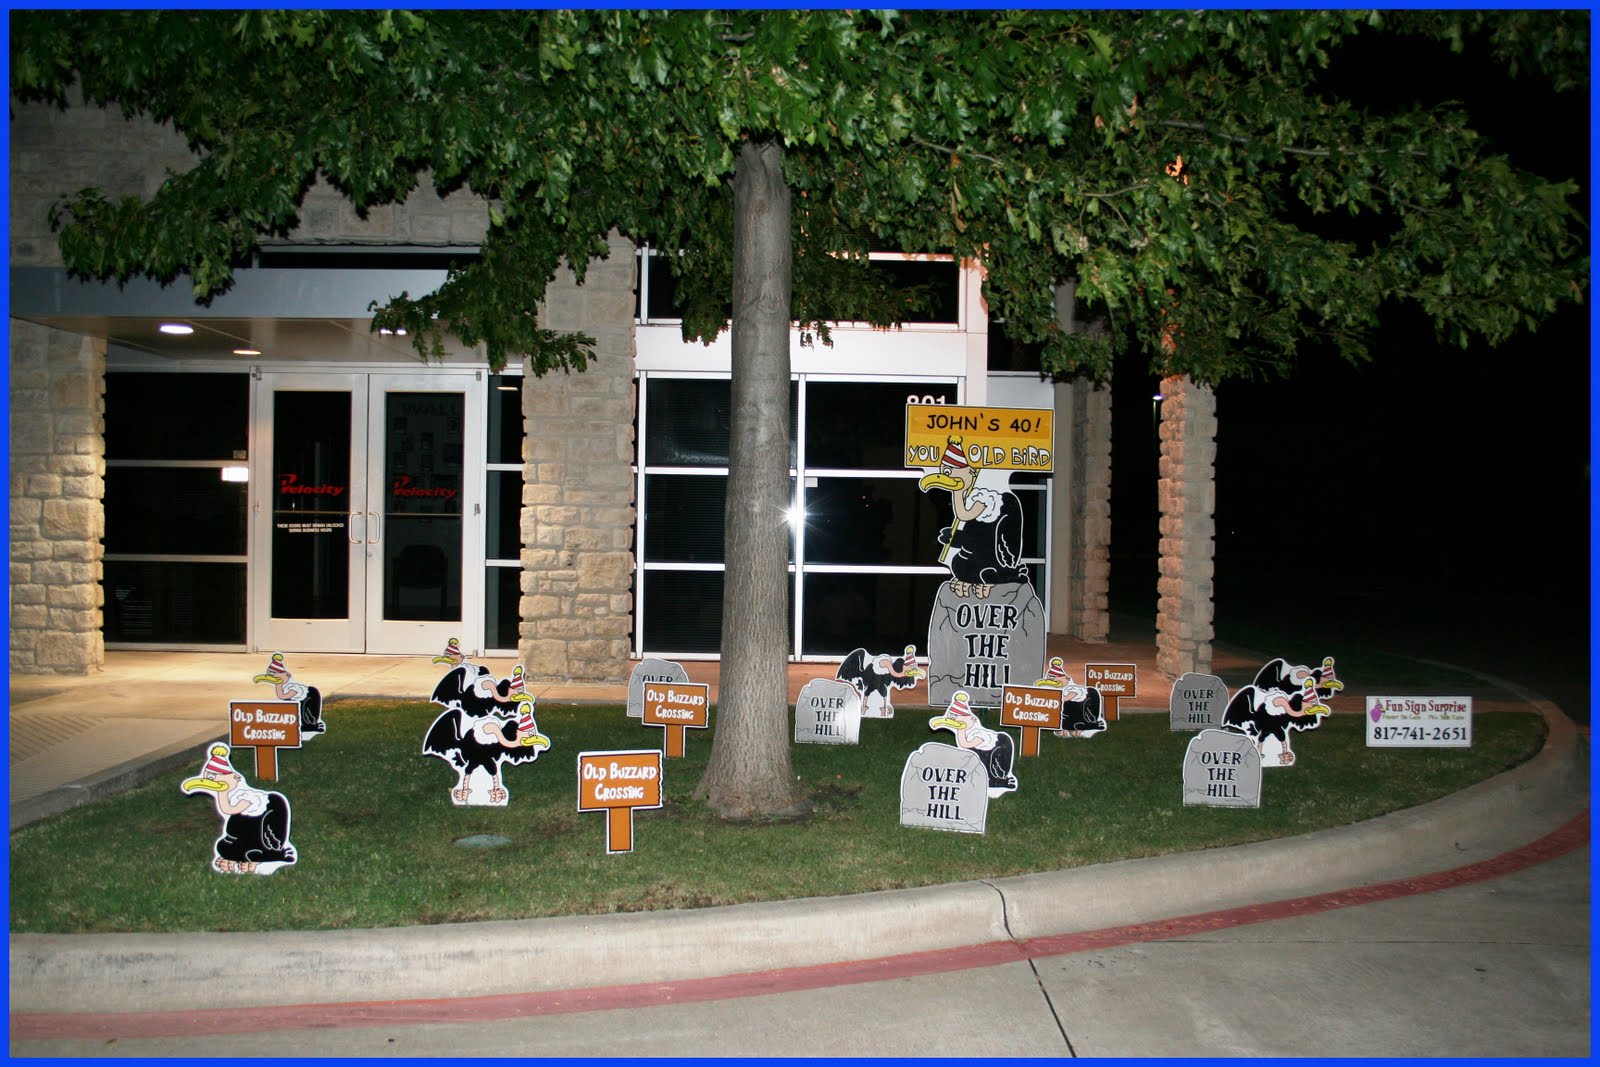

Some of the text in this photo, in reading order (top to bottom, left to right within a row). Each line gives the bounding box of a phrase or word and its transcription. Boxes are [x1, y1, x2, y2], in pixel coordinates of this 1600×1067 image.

[927, 413, 1041, 432] JOHN'S 40!
[908, 445, 940, 462] YOU
[968, 443, 1005, 466] OLD
[957, 605, 1017, 629] OVER
[965, 634, 1009, 658] THE
[964, 664, 1010, 688] HILL
[1184, 690, 1214, 699] OVER
[811, 697, 844, 708] OVER
[1188, 702, 1210, 711] THE
[1385, 700, 1467, 715] Fun Sign Surprise
[816, 711, 839, 722] THE
[1188, 714, 1213, 724] HILL
[815, 724, 844, 736] HILL
[1373, 726, 1467, 740] 817-741-2651
[1201, 751, 1242, 765] OVER
[922, 766, 967, 784] OVER
[1207, 767, 1236, 781] THE
[928, 785, 960, 801] THE
[1206, 784, 1241, 798] HILL
[926, 803, 964, 821] HILL
